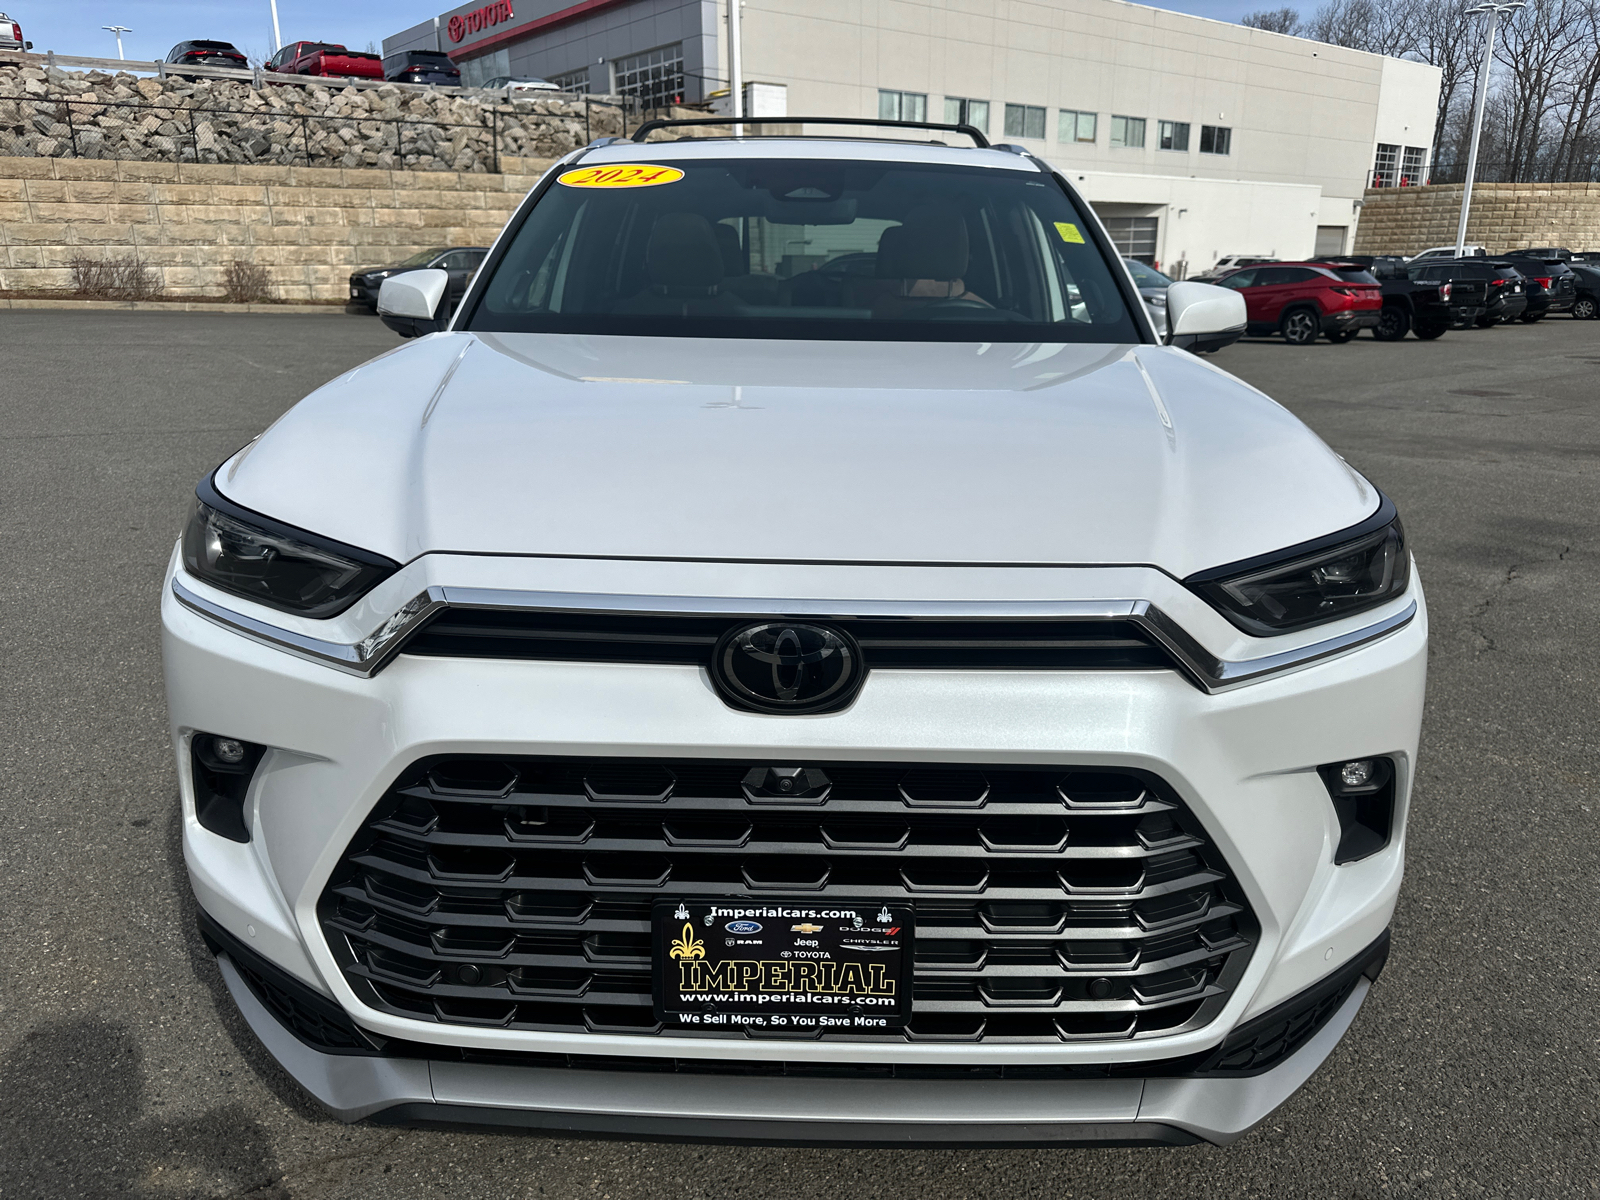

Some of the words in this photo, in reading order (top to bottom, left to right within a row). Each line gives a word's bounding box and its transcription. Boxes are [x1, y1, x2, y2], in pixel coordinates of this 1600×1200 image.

[464, 0, 514, 34] TOYOTA
[571, 169, 669, 184] 2024
[710, 906, 856, 919] Imperialcars.com
[733, 923, 754, 932] Ford
[794, 938, 819, 948] Jeep
[794, 951, 831, 959] TOYOTA
[679, 960, 896, 996] IMPERIAL
[680, 992, 895, 1006] www.imperialcars.com
[679, 1013, 700, 1023] We
[703, 1014, 727, 1024] Sell
[731, 1015, 767, 1026] More,
[770, 1015, 788, 1025] So
[791, 1016, 816, 1026] You
[819, 1016, 851, 1026] Save
[854, 1017, 887, 1027] More
